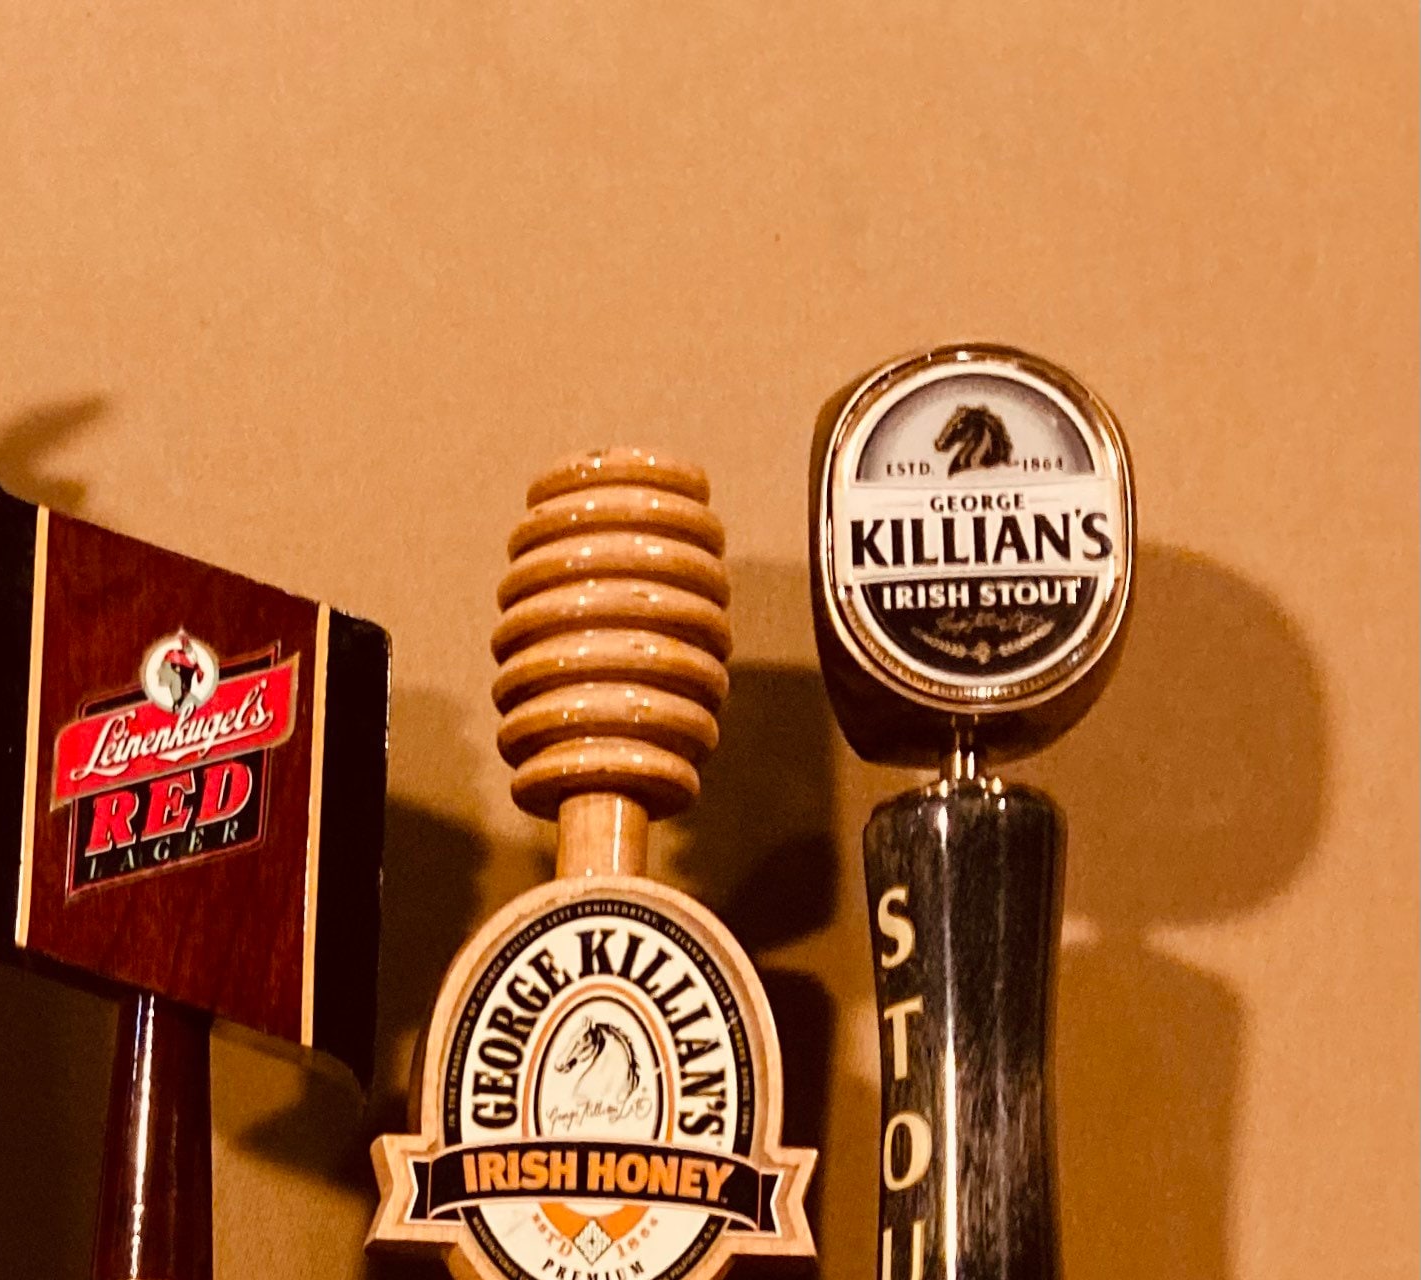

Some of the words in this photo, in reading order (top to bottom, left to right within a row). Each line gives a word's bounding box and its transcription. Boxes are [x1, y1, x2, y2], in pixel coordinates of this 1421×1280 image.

[929, 492, 1027, 514] GEORGE
[849, 508, 1114, 570] KILLIAN'S
[882, 581, 971, 611] IRISH
[979, 578, 1083, 607] STOUT
[69, 677, 275, 782] Leinenkugel's
[84, 759, 254, 858] RED
[86, 819, 241, 881] LAGER
[471, 946, 574, 1130] GEORGE
[575, 928, 727, 1137] KILLIAN'S
[463, 1149, 579, 1194] IRISH
[586, 1152, 735, 1199] HONEY
